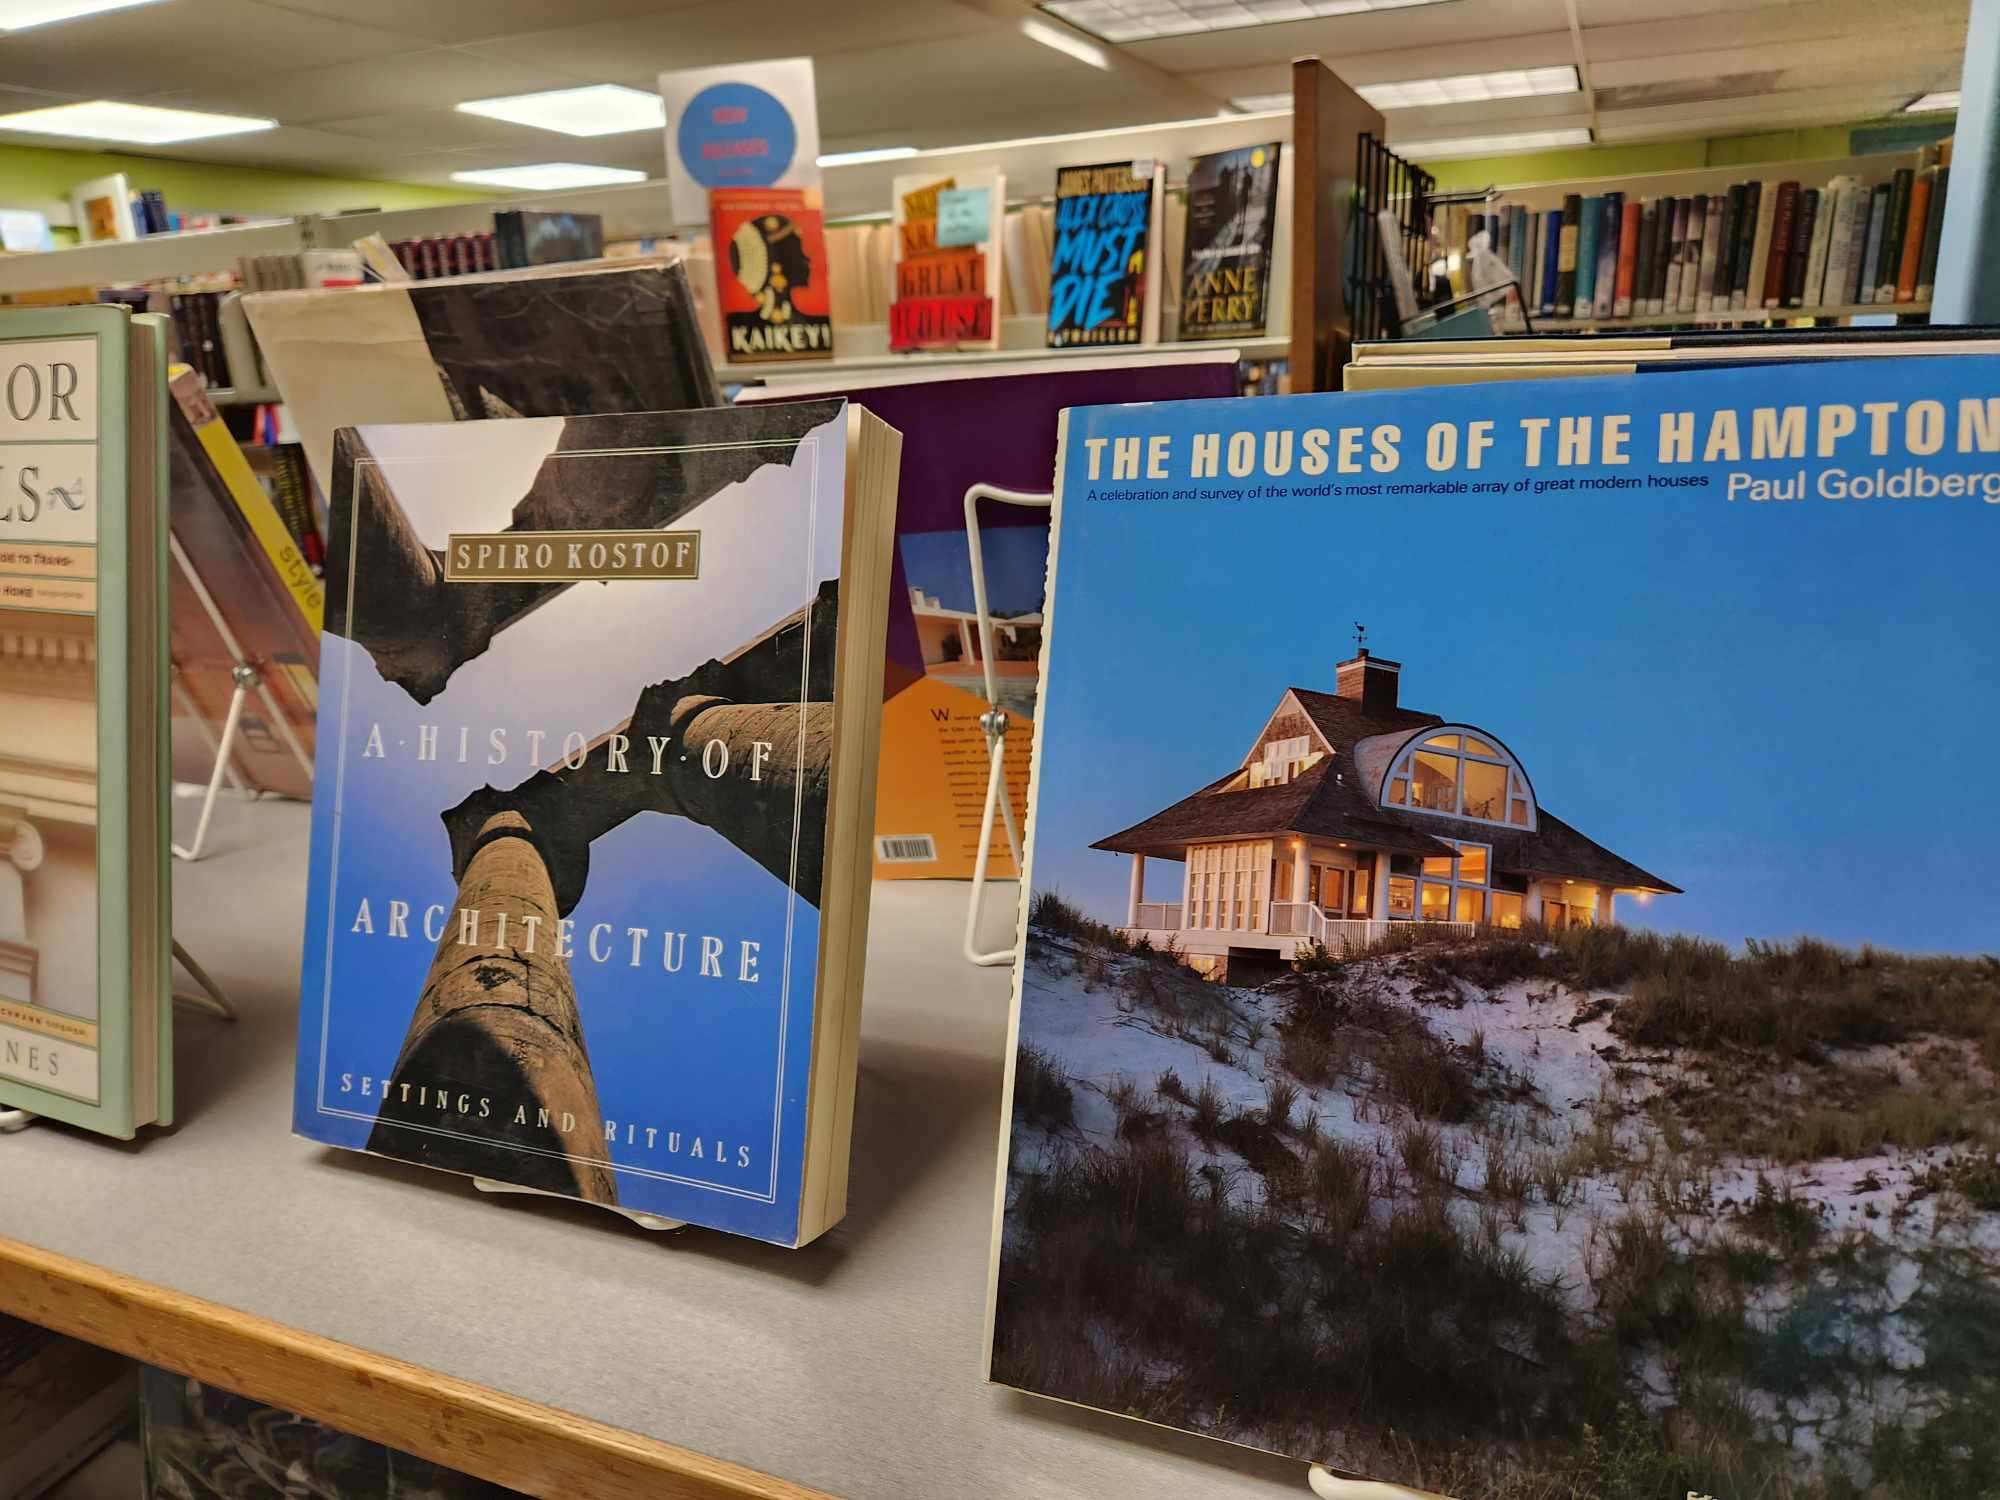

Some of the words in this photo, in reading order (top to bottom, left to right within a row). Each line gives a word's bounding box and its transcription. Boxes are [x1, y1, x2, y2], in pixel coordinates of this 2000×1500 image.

[1052, 226, 1147, 275] MUST
[1049, 272, 1124, 331] DIE
[1187, 267, 1257, 297] ANNE
[1185, 295, 1257, 322] PERRY
[732, 324, 830, 353] KAIKEYI
[7, 362, 80, 421] OR
[1085, 436, 1171, 481] THE
[1190, 424, 1402, 479] HOUSES
[1425, 420, 1495, 472] OF
[1519, 414, 1631, 467] THE
[1657, 398, 2000, 464] HAMPTON
[1087, 489, 1097, 501] A
[1100, 486, 1169, 501] celebration
[1172, 487, 1197, 500] and
[1200, 488, 1242, 501] survey
[1247, 485, 1263, 499] of
[1265, 485, 1288, 498] the
[1346, 483, 1382, 496] most
[1386, 480, 1468, 495] remarkable
[1472, 481, 1509, 495] array
[1513, 478, 1530, 492] of
[1534, 477, 1576, 494] great
[1579, 475, 1642, 489] modern
[1647, 474, 1709, 488] houses
[1727, 470, 1805, 501] Paul
[1817, 466, 2000, 504] Goldberg
[456, 543, 553, 570] SPIRO
[567, 541, 691, 569] KOSTOF
[362, 722, 385, 758] A
[416, 724, 672, 776] HISTORY
[702, 738, 773, 782] OF
[351, 897, 761, 983] ARCHITECTURE
[6, 1040, 58, 1077] NES
[340, 1072, 490, 1118] SETTINGS
[513, 1105, 577, 1134] AND
[604, 1119, 751, 1169] RITUALS
